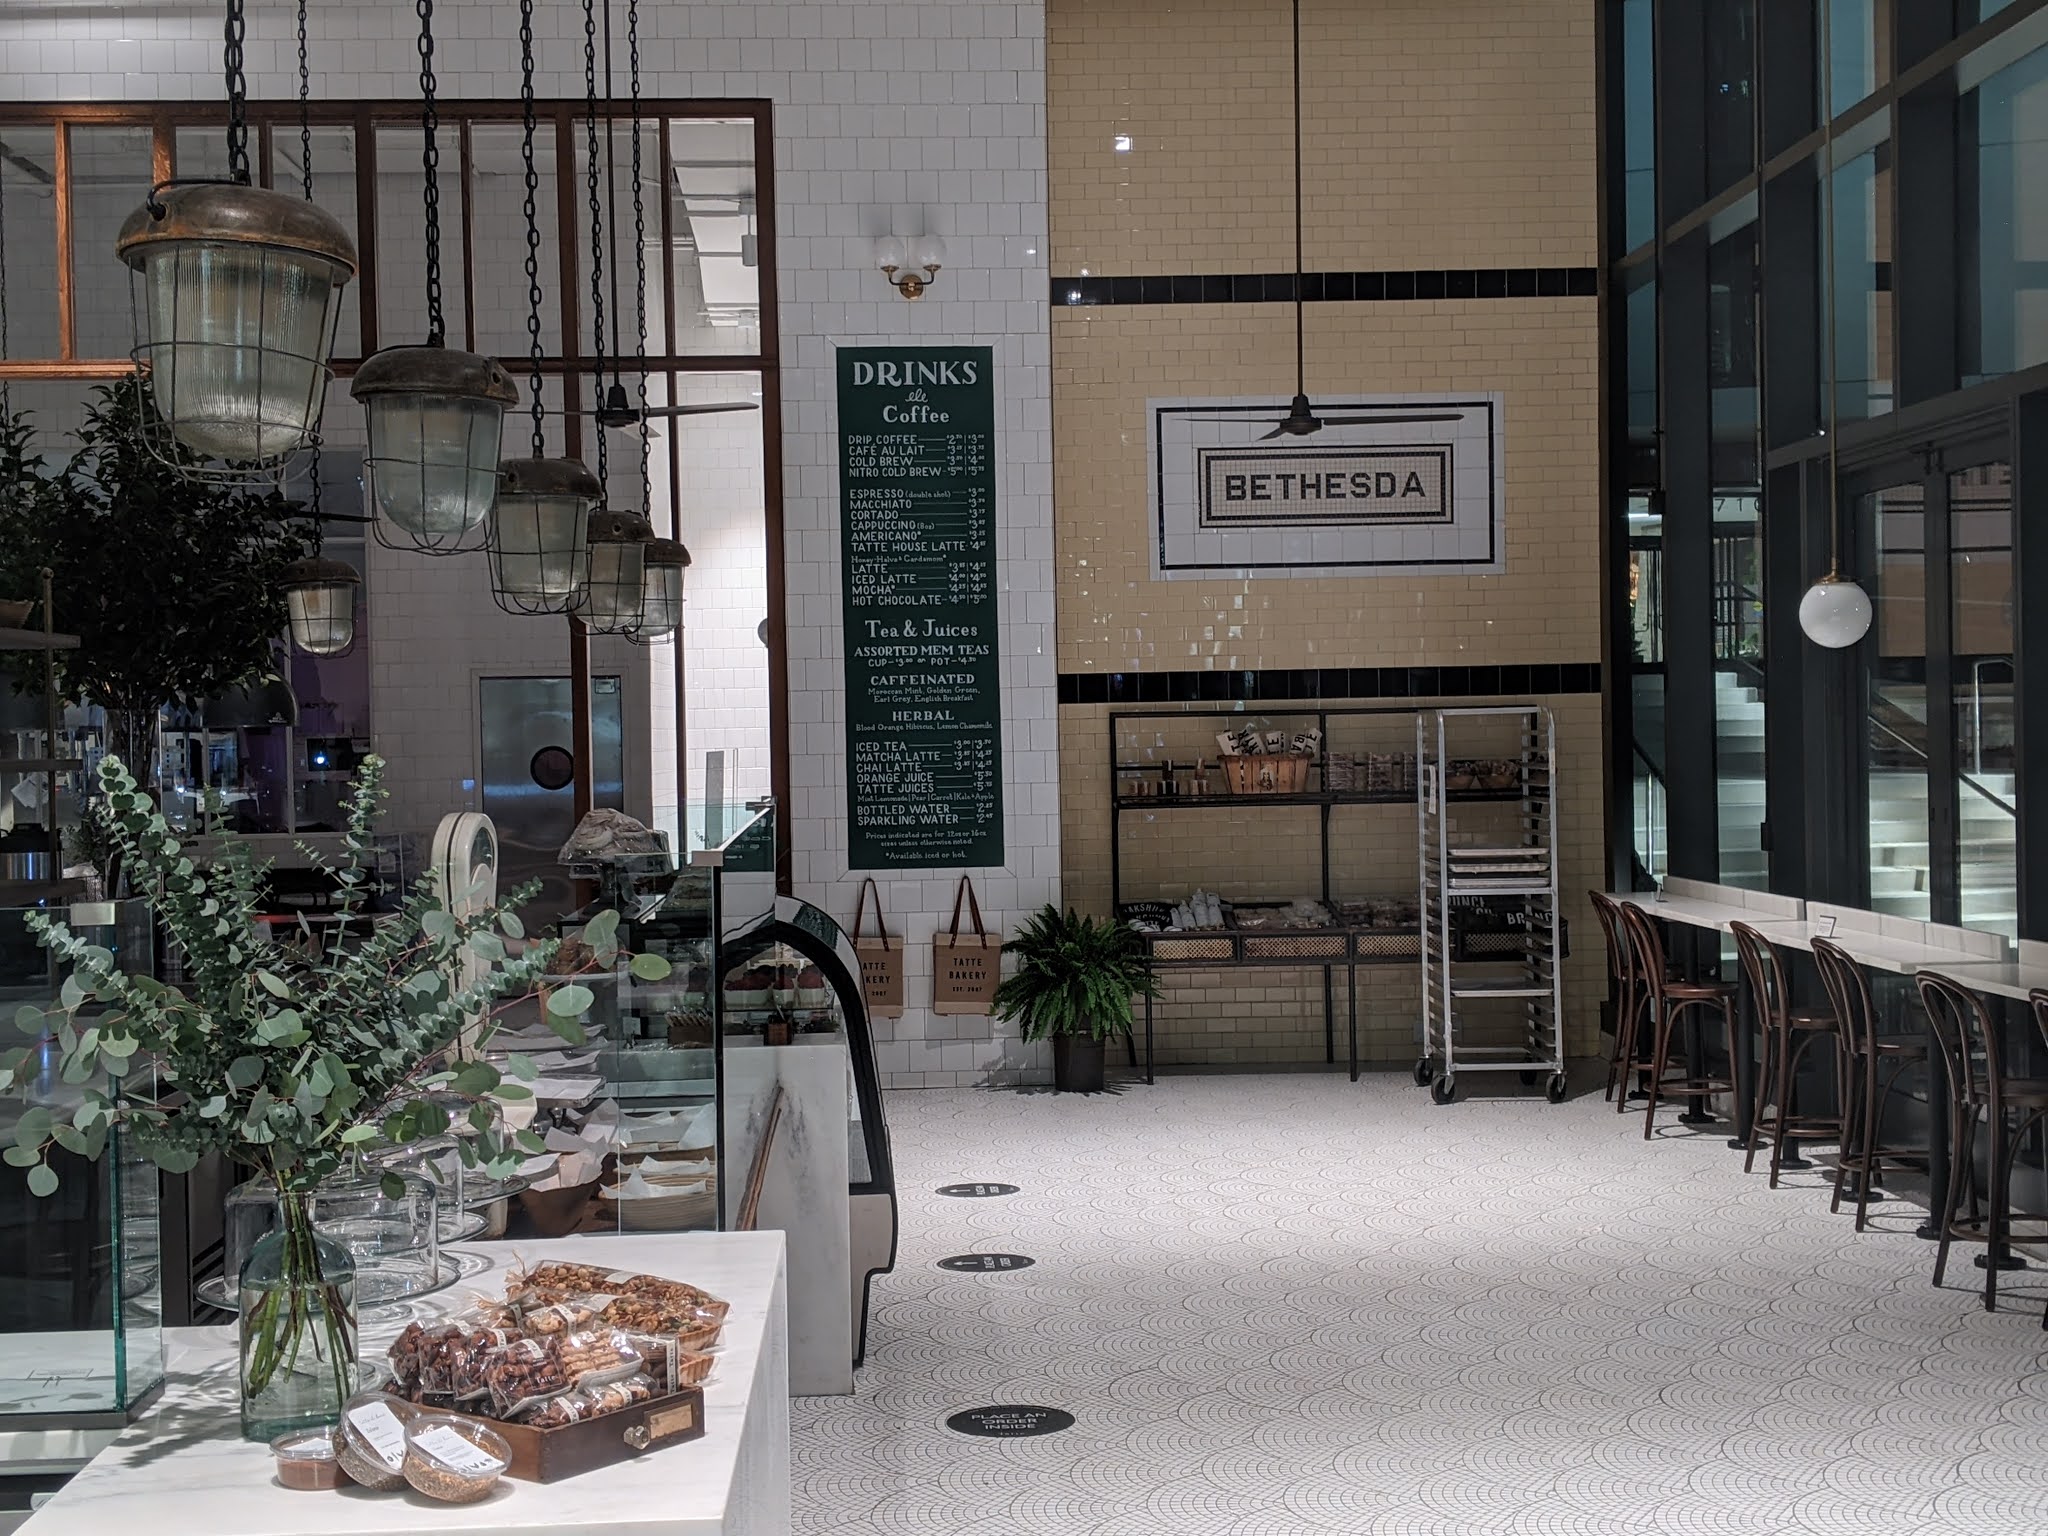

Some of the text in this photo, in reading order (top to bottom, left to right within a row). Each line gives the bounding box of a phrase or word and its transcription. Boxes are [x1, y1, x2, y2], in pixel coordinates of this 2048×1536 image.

[853, 361, 978, 387] DRINKS
[883, 405, 950, 423] Coffee
[848, 435, 873, 445] DRIP
[876, 435, 917, 445] COFFEE
[849, 443, 877, 456] CAFÉ
[881, 445, 896, 456] AU
[899, 445, 925, 455] LAIT
[849, 456, 876, 467] COLD
[879, 456, 914, 466] BREW
[849, 467, 879, 478] NITRO
[882, 467, 906, 477] COLD
[909, 467, 942, 477] BREW
[1225, 471, 1426, 501] BETHESDA
[850, 488, 904, 499] ESPRESSO
[850, 499, 912, 510] MACCHIATO
[851, 510, 899, 520] CORTADO
[851, 520, 916, 530] CAPPUCCINO
[852, 542, 888, 552] TATTE
[892, 542, 928, 552] HOUSE
[932, 541, 966, 551] LATTE
[851, 563, 889, 574] LATTE
[851, 575, 876, 584] ICED
[880, 574, 917, 584] LATTE
[852, 596, 873, 606] HOT
[878, 595, 942, 605] CHOCOLATE
[865, 618, 978, 638] Tea & Juices
[854, 644, 989, 657] ASSORTED MEM TEAS
[870, 674, 975, 686] CAFFEINATED
[868, 687, 903, 695] Moroccan
[914, 695, 942, 704] English
[943, 694, 973, 702] Breakfast
[892, 710, 955, 722] HERBAL
[856, 723, 876, 732] Blood
[877, 724, 904, 732] Orange
[937, 722, 959, 730] Lemon
[856, 742, 880, 752] ICED
[884, 742, 907, 751] TEA
[856, 752, 901, 762] MATCHA
[905, 751, 941, 761] LATTE
[856, 763, 882, 773] CHAI
[886, 762, 922, 772] LATTE
[856, 773, 900, 784] ORANGE
[904, 772, 934, 783] JUICE
[857, 784, 894, 794] TATTE
[898, 783, 934, 793] JUICES
[857, 805, 905, 815] BOTTLED
[909, 804, 950, 814] WATER
[857, 815, 916, 826] SPARKLING
[919, 814, 959, 825] WATER
[888, 831, 920, 839] indicated
[863, 962, 886, 971] ATTE
[953, 958, 982, 967] TATTE
[866, 975, 891, 984] KERY
[949, 971, 987, 979] BAKERY
[536, 1374, 555, 1384] Tatte
